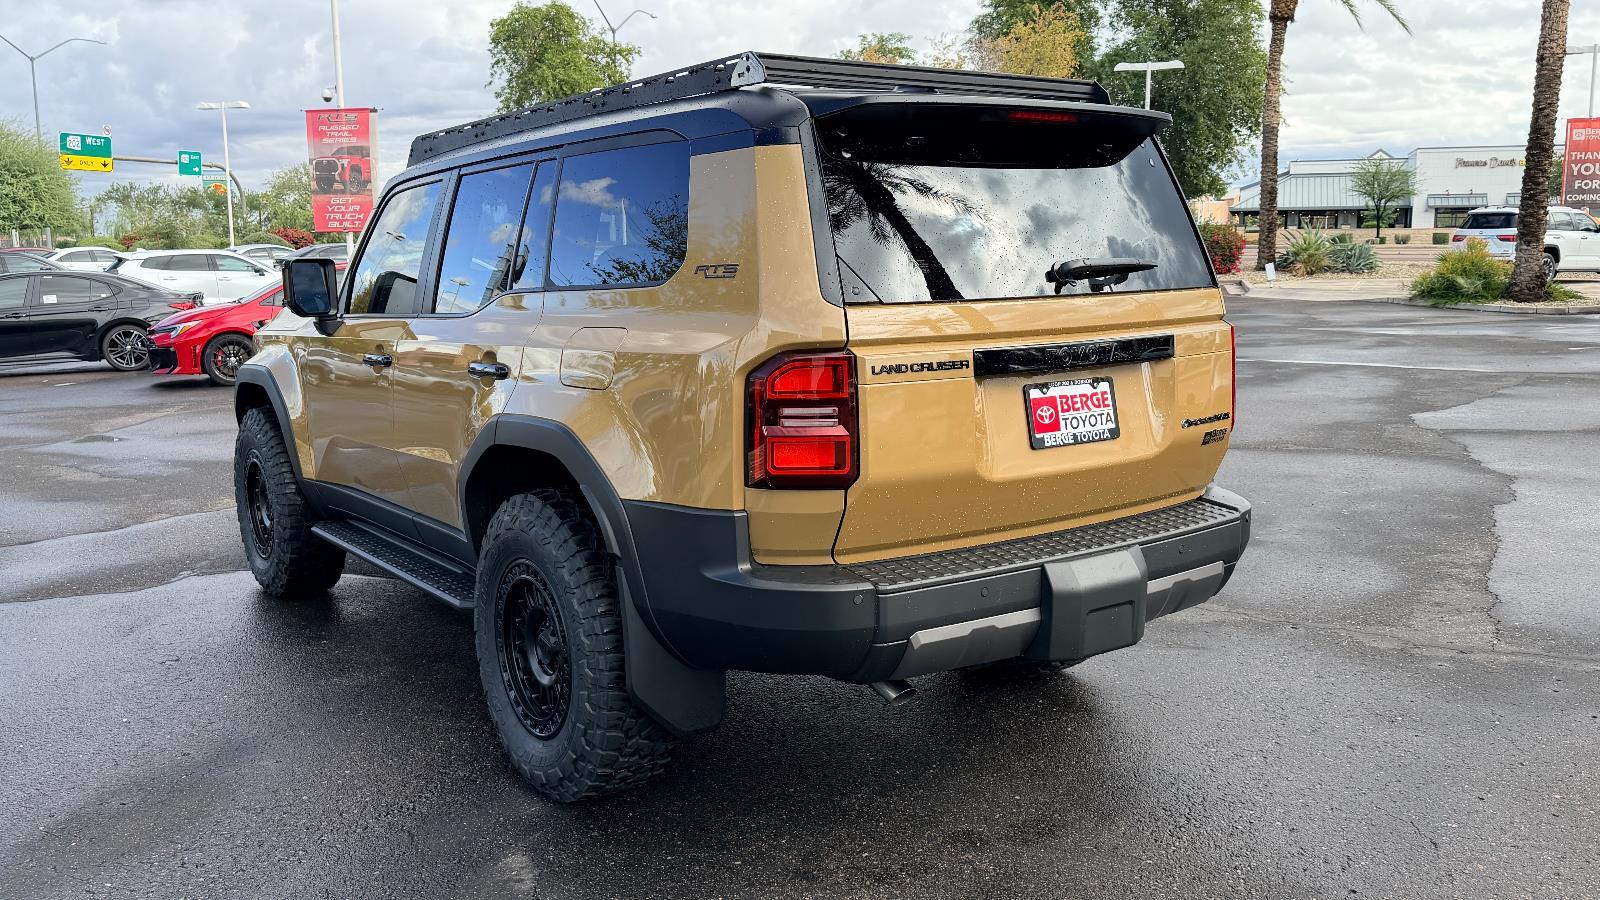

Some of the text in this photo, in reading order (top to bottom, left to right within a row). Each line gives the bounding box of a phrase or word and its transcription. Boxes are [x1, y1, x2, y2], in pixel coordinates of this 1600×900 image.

[85, 136, 105, 147] WEST
[79, 159, 94, 167] ONLY
[1574, 179, 1600, 189] FOR
[694, 263, 739, 279] RTS
[1046, 342, 1126, 367] TOYOTA
[871, 359, 970, 376] LAND CRUISER
[1058, 391, 1111, 413] BERGE
[1061, 412, 1114, 430] TOYOTA
[1044, 429, 1111, 447] BERGE TOYOTA
